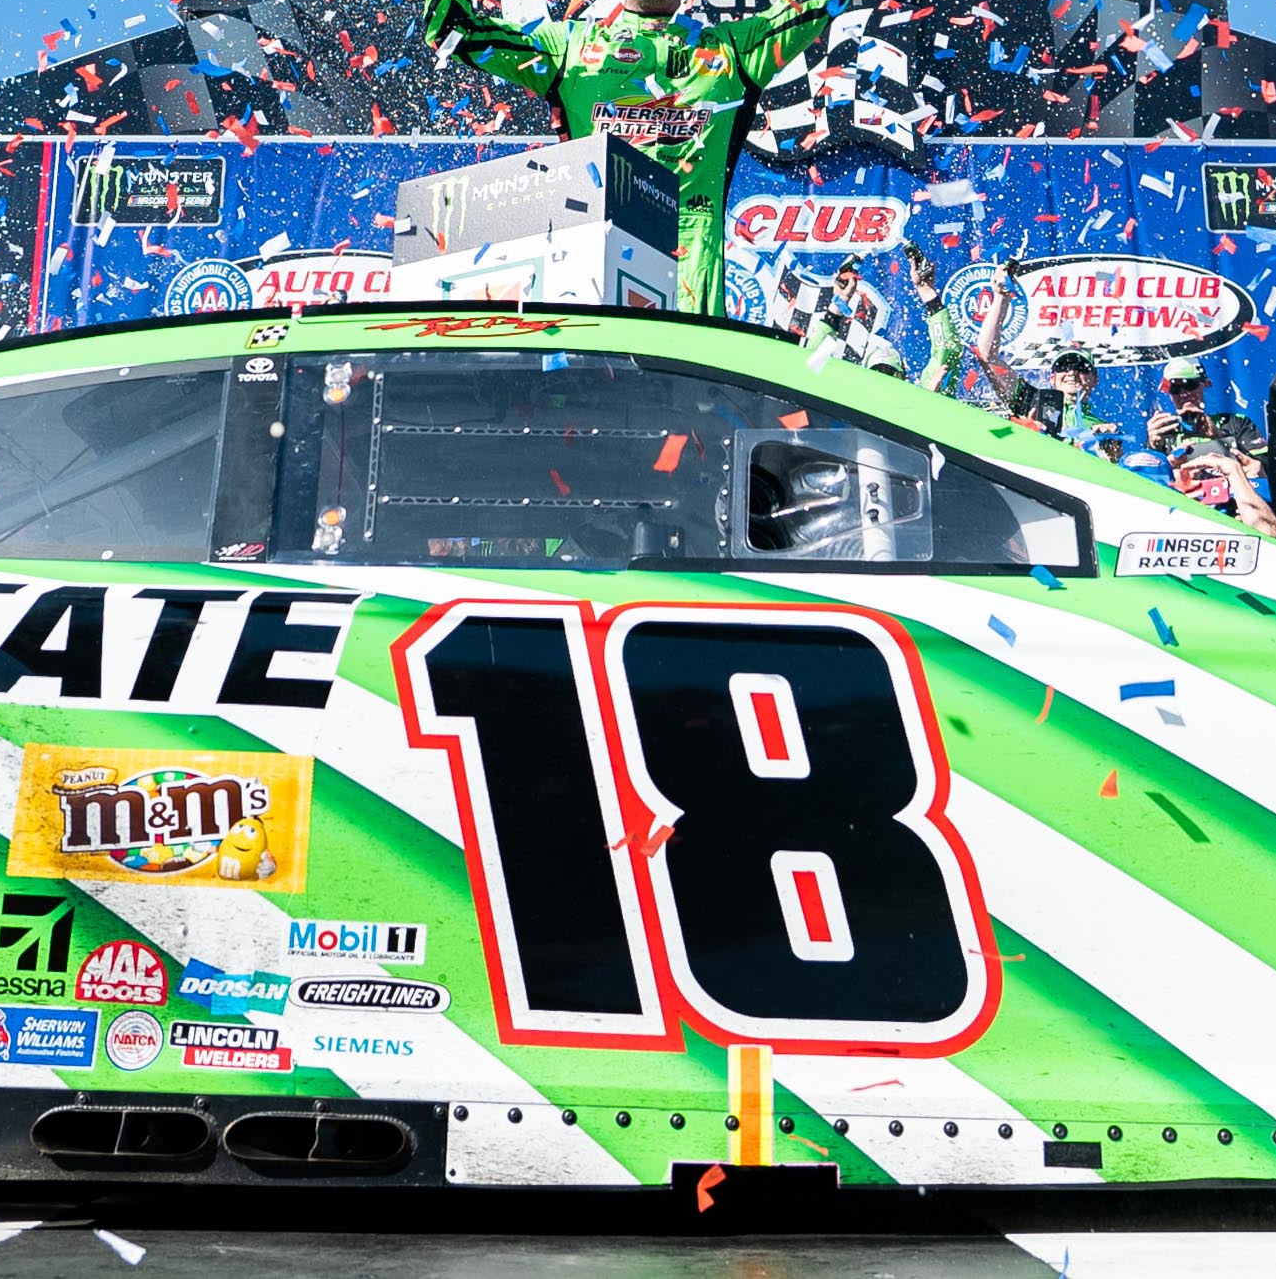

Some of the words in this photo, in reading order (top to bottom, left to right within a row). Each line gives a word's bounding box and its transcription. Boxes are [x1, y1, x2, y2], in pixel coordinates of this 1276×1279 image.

[595, 106, 709, 121] INTERSTATE
[600, 122, 700, 136] BATTERIES
[128, 168, 215, 186] MONSTER
[472, 164, 572, 201] MONSTER
[485, 188, 556, 210] ENERGY
[633, 175, 678, 212] MONSTER
[734, 205, 896, 243] CLUB
[175, 264, 231, 295] AUTOMOBILE
[228, 272, 249, 295] CLUB
[256, 271, 351, 293] AUTO
[1031, 275, 1126, 298] AUTO
[1136, 276, 1221, 298] CLUB
[190, 291, 229, 311] AAA
[1037, 305, 1221, 328] SPEEDWAY
[237, 373, 278, 382] TOYOTA
[1164, 539, 1240, 553] NASCAR
[1139, 557, 1190, 568] RACE
[1198, 557, 1236, 568] CAR
[63, 772, 106, 783] PEANUT
[405, 606, 986, 1041] 18
[288, 922, 377, 952] Mobil
[81, 944, 163, 988] MAC
[81, 982, 163, 1003] TOOLS
[180, 977, 288, 1000] DOOSAN
[303, 983, 436, 1007] FREIGHTLINER
[22, 1016, 86, 1033] SHERWIN
[16, 1031, 85, 1049] WILLIAMS
[114, 1034, 156, 1046] NATCA
[174, 1025, 273, 1049] LINCOLN
[313, 1035, 414, 1056] SIEMENS
[193, 1050, 279, 1069] WELDERS
